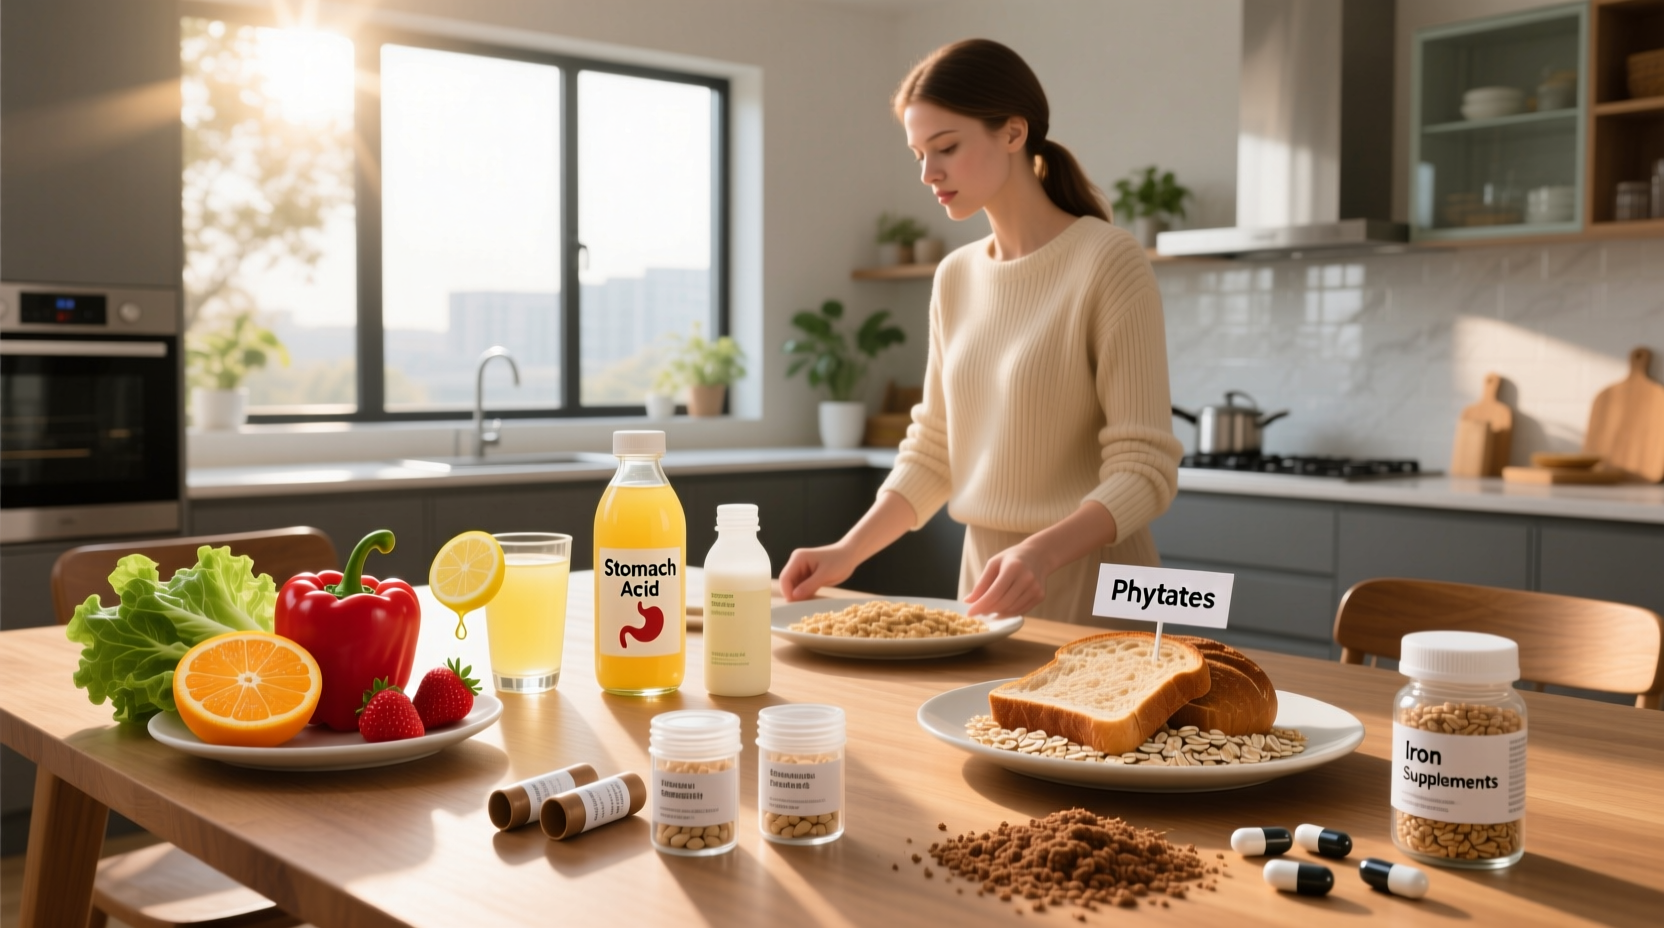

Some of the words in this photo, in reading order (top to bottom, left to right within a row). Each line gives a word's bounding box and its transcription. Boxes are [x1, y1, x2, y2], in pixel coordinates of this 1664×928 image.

[604, 558, 677, 577] Stomach
[620, 580, 660, 597] Acid
[1111, 579, 1216, 611] Phytates
[1405, 740, 1442, 766] Iron
[1403, 765, 1499, 790] Supplements
